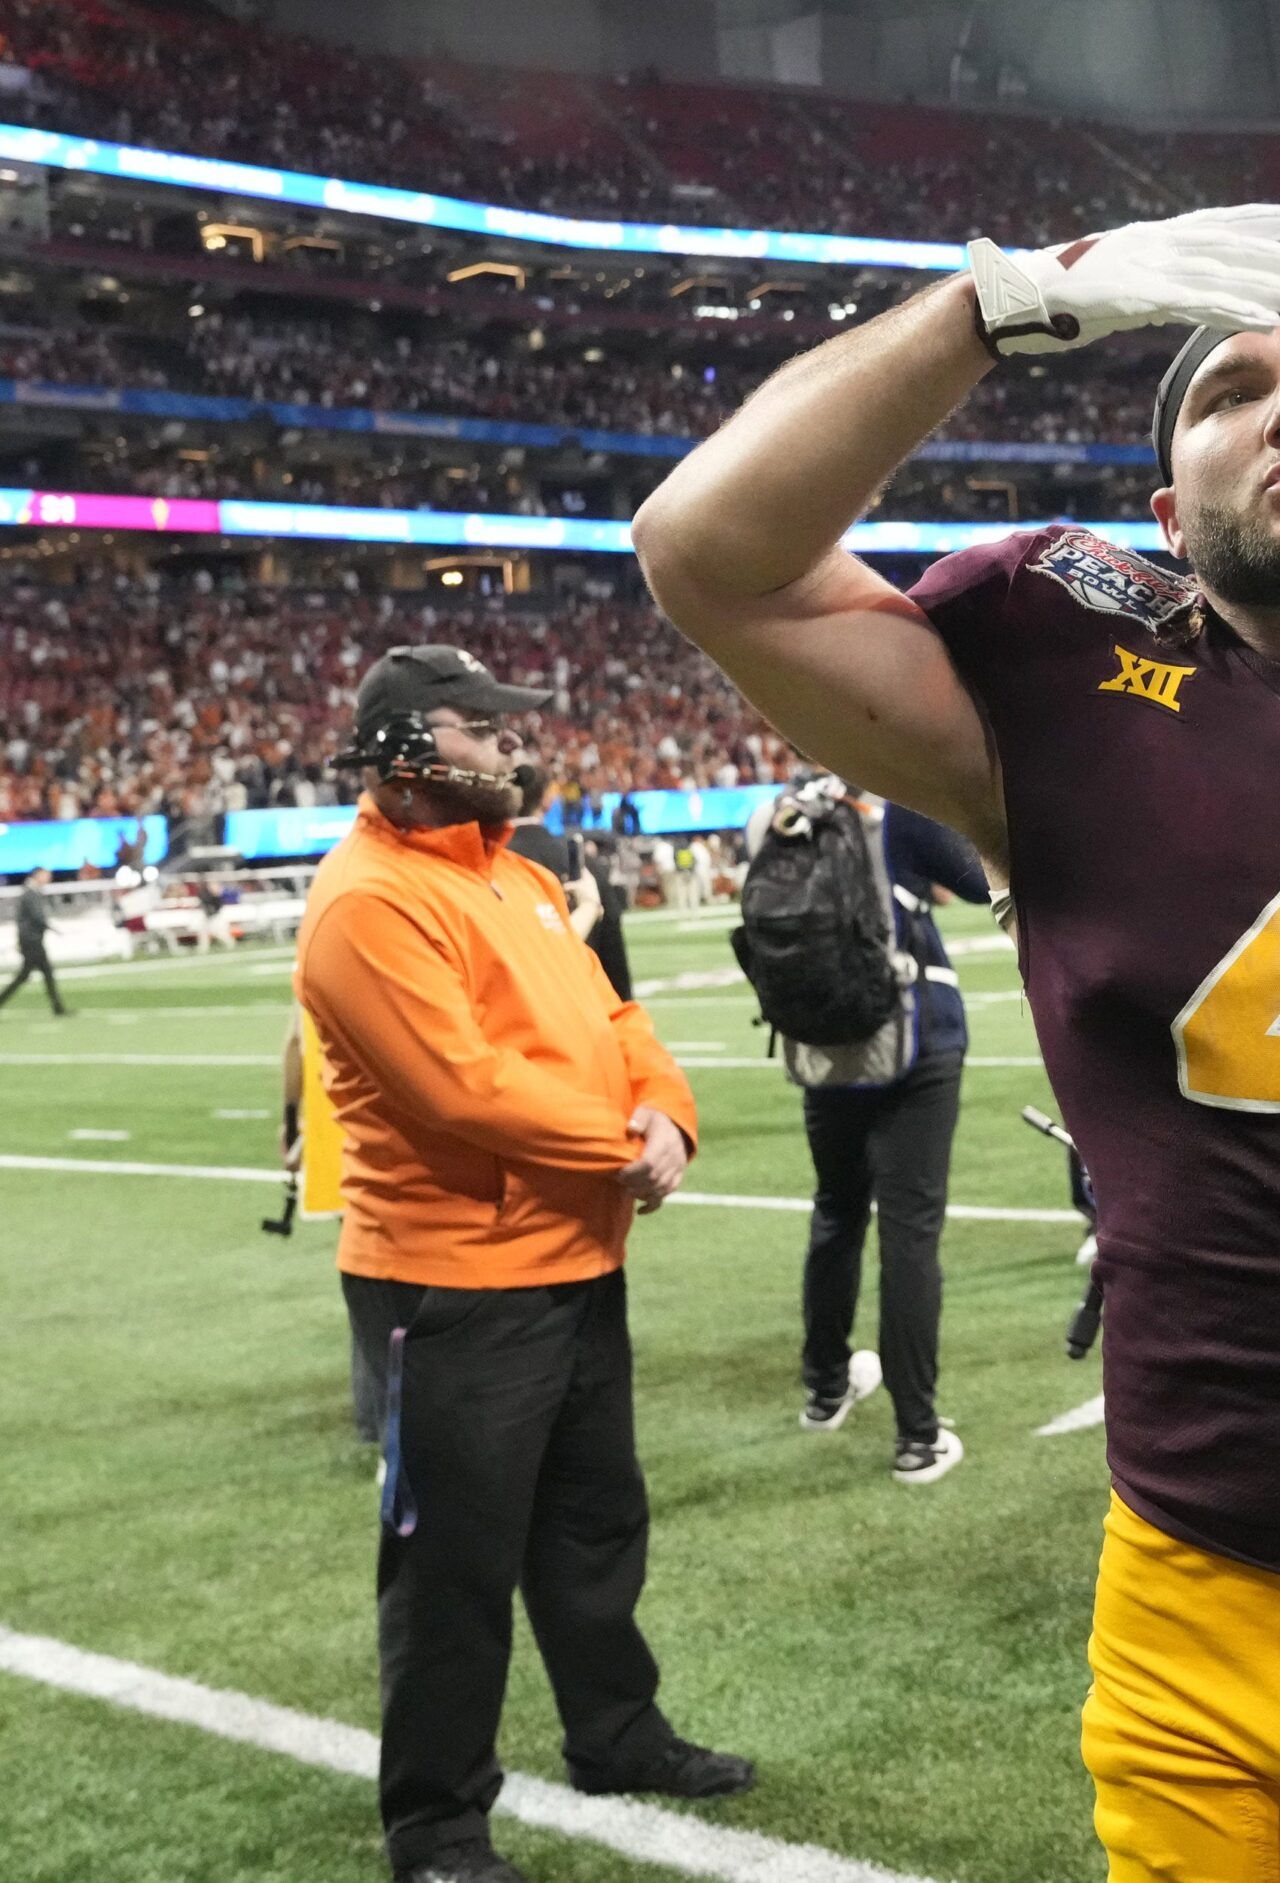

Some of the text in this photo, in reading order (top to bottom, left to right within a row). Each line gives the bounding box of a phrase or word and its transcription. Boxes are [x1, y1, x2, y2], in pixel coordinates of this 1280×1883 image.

[1051, 545, 1179, 618] PEACH
[1068, 568, 1137, 610] BOWL
[1097, 644, 1197, 712] XII
